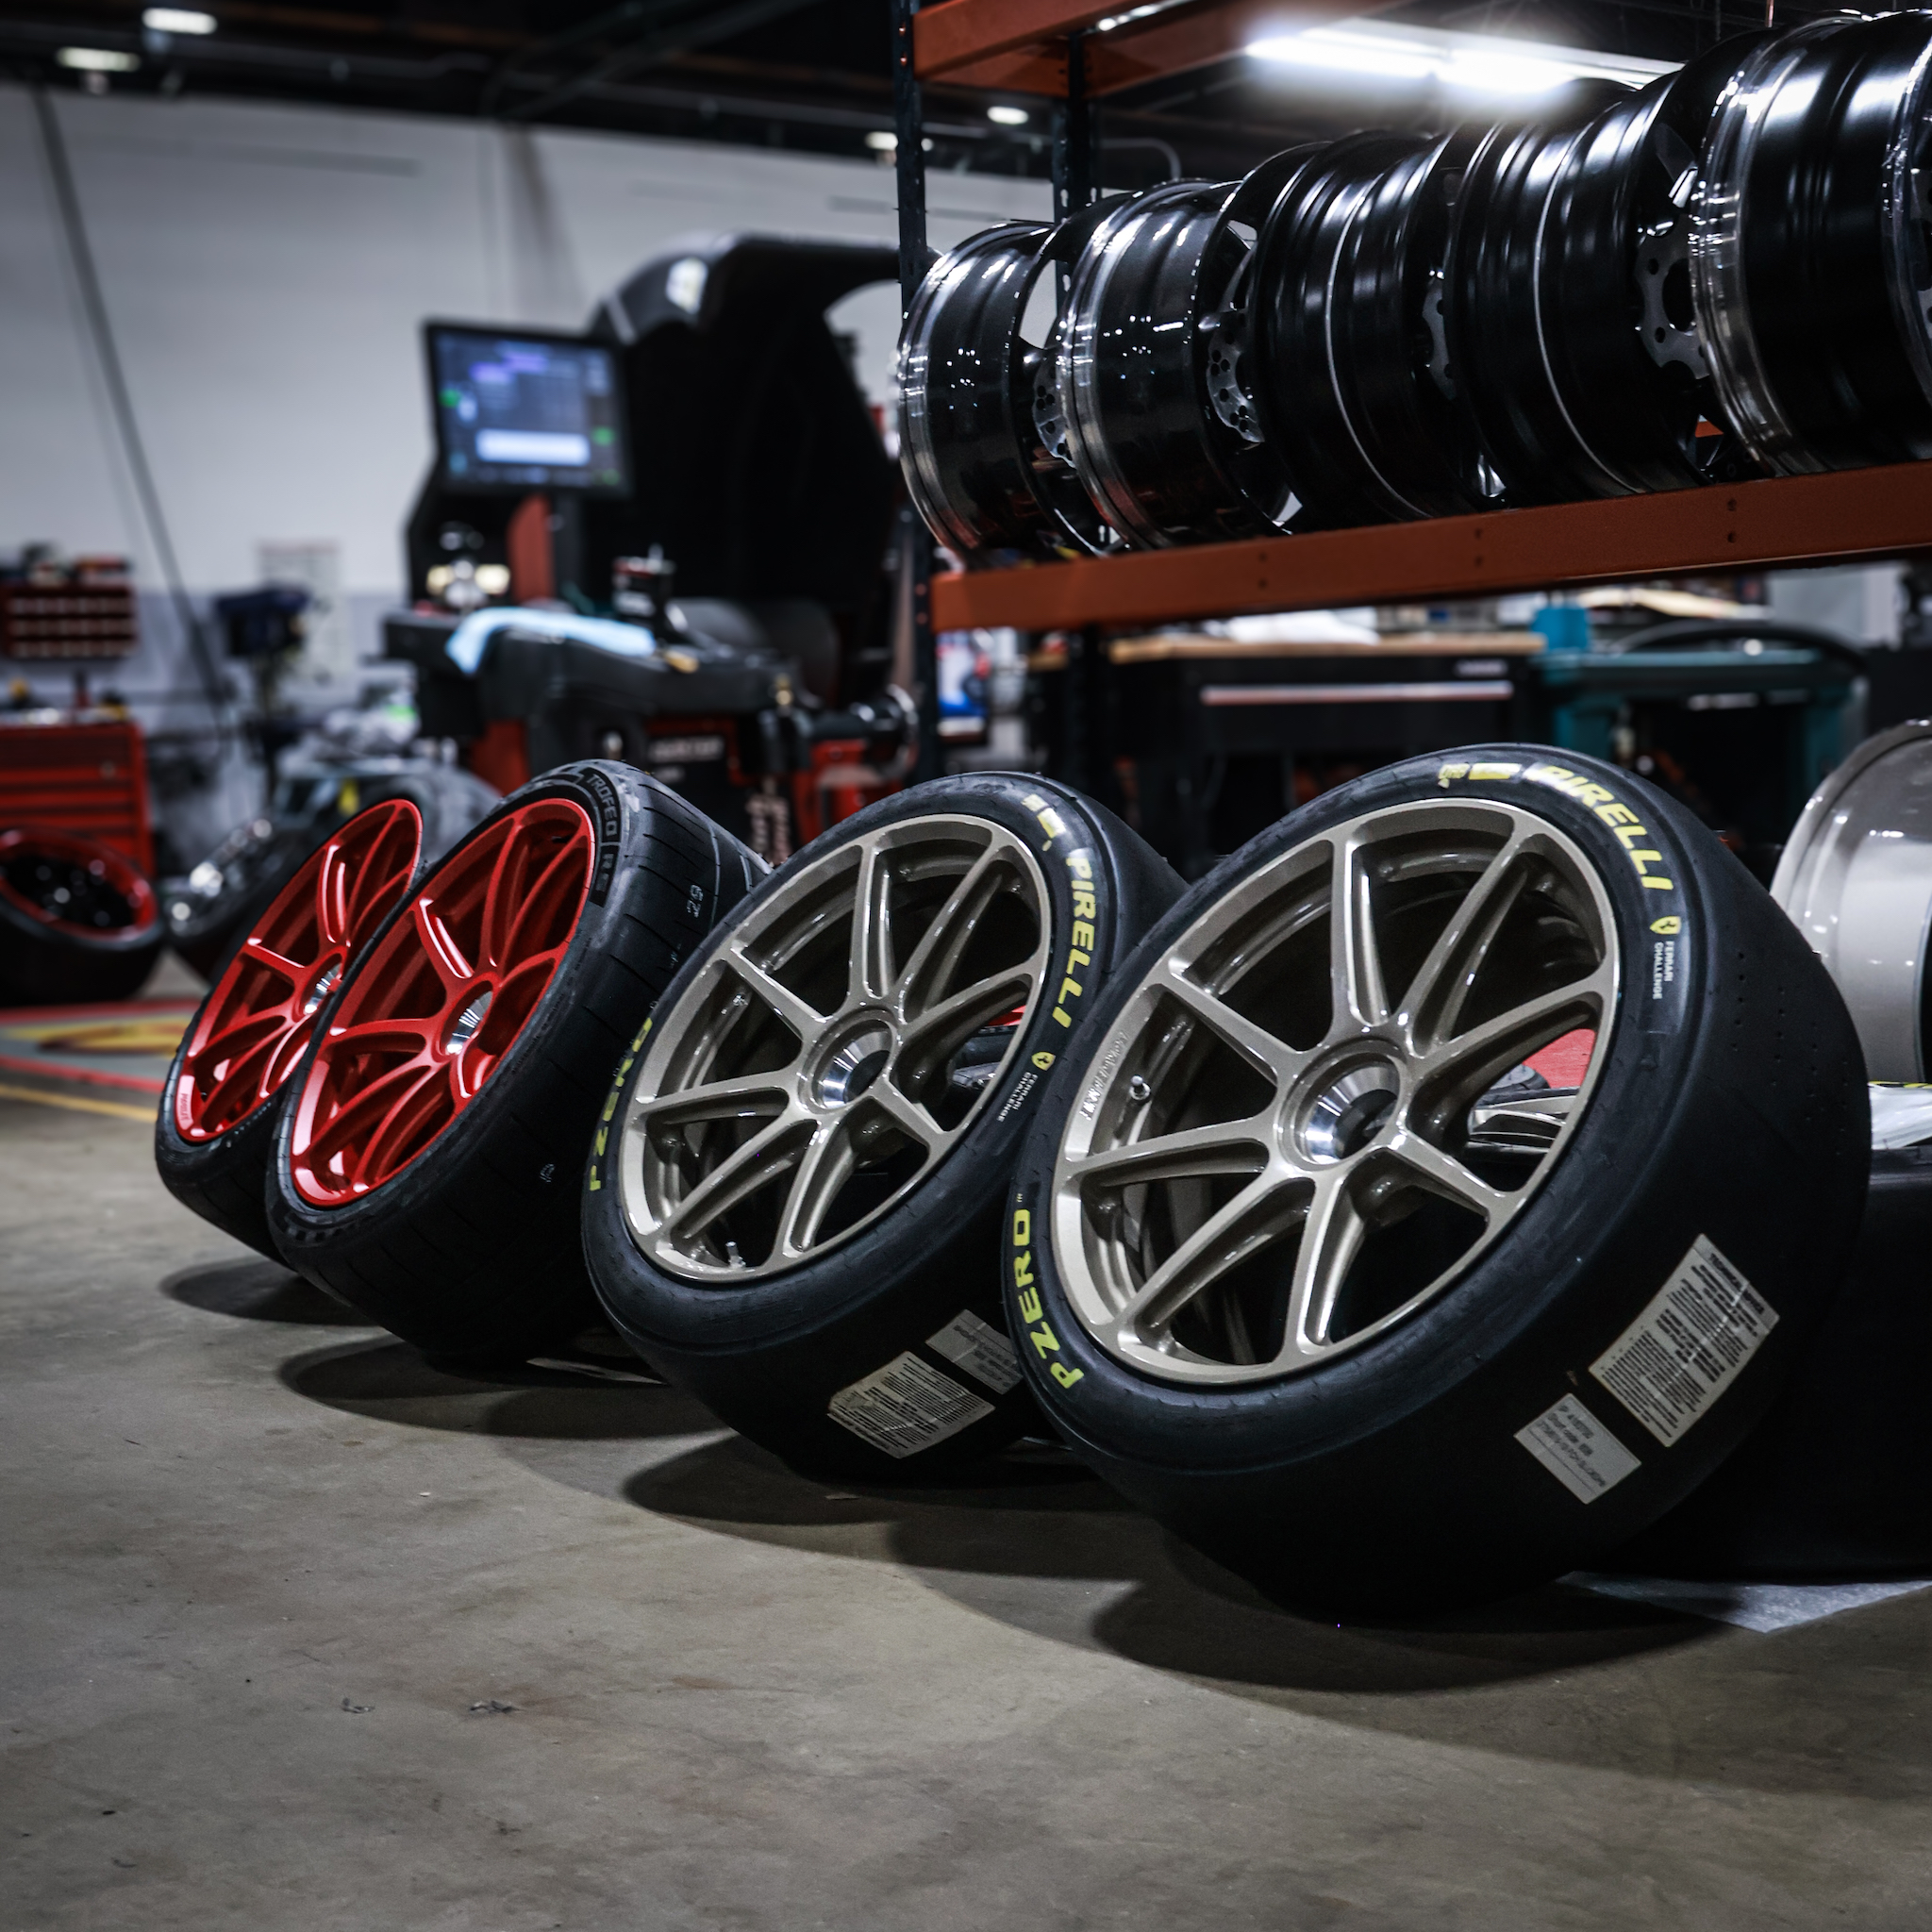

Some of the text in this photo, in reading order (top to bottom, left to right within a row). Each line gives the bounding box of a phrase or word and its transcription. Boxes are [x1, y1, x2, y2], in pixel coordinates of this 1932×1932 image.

[586, 774, 618, 837] TROFEO
[1523, 762, 1674, 891] PIRELLI
[1052, 848, 1096, 1029] PIRELLI
[1663, 941, 1675, 982] FERRARI
[1654, 941, 1663, 1000] CHALLENGE
[997, 1072, 1032, 1123] CHALLENGE
[1011, 1074, 1039, 1111] FERRARI
[1012, 1208, 1084, 1389] P ZERO
